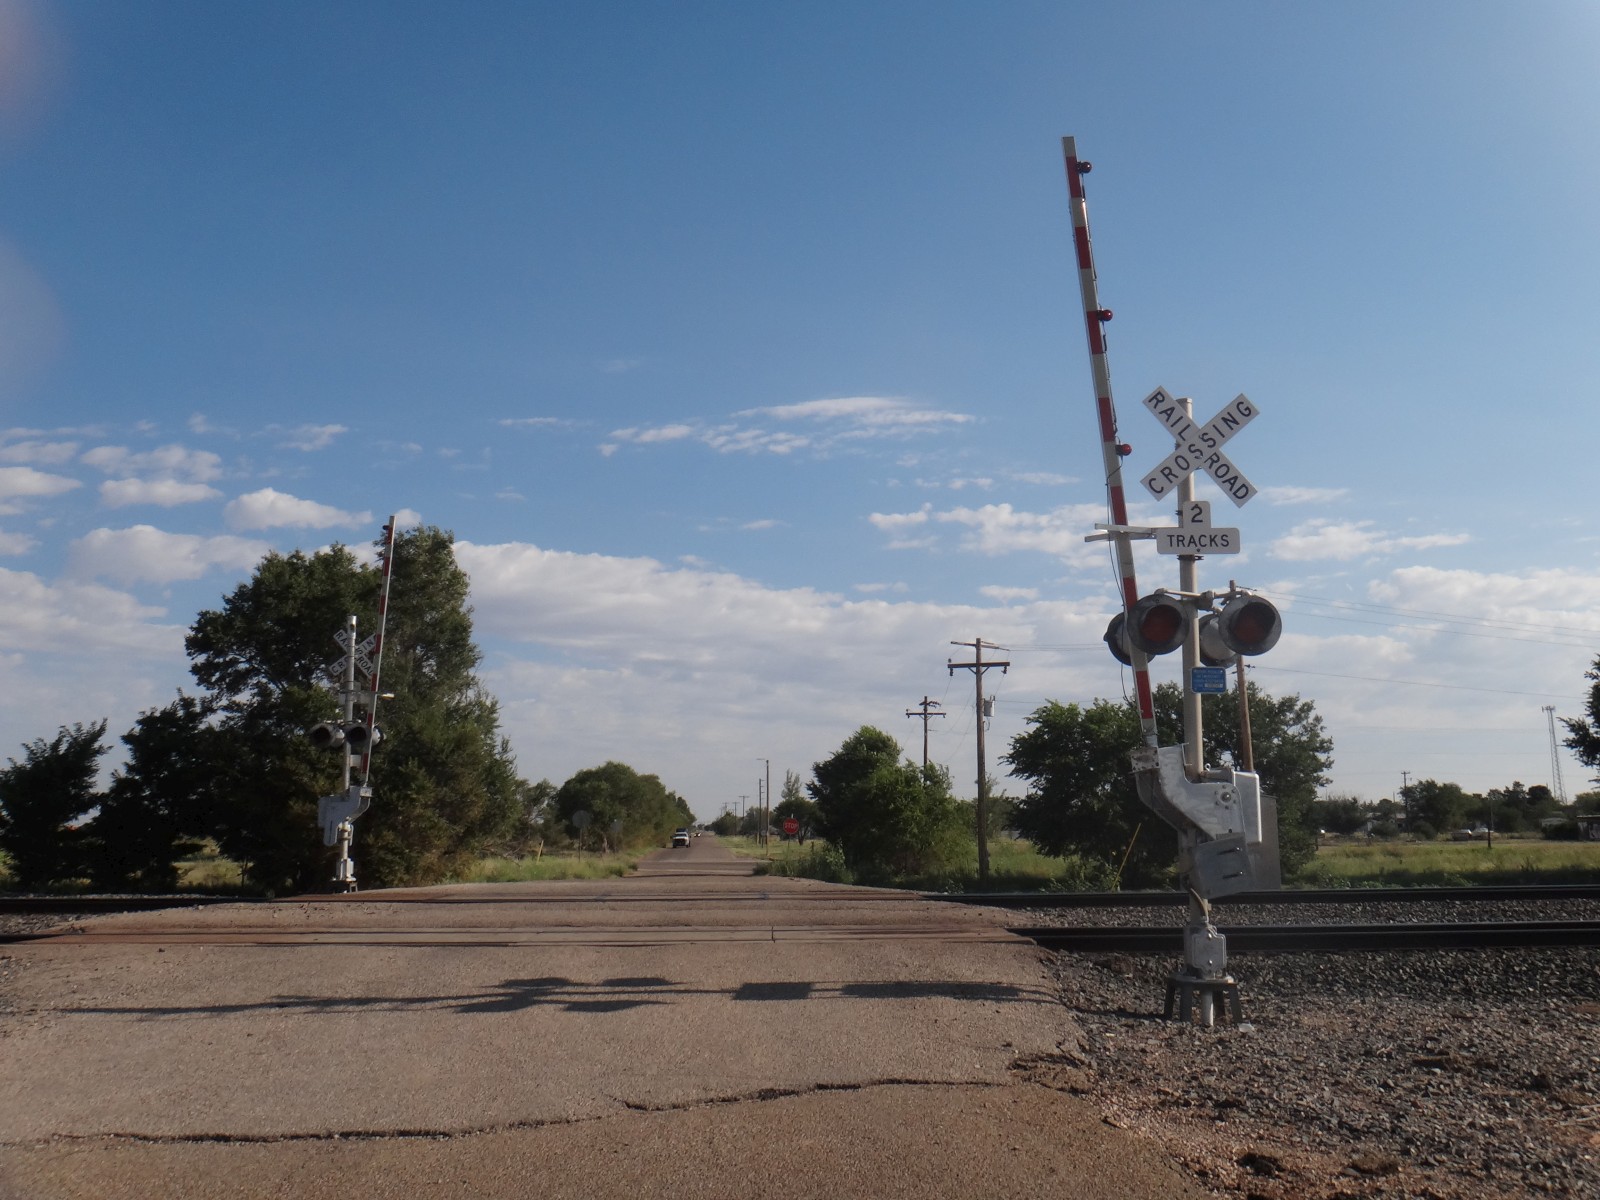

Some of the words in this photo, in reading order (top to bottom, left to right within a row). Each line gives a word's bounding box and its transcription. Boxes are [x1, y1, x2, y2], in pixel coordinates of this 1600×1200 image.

[1148, 391, 1192, 441] RAIL
[1204, 452, 1249, 500] ROAD
[1148, 401, 1252, 494] CROSSING
[1190, 504, 1203, 523] 2
[1167, 534, 1230, 548] TRACKS
[784, 822, 798, 830] STOP
